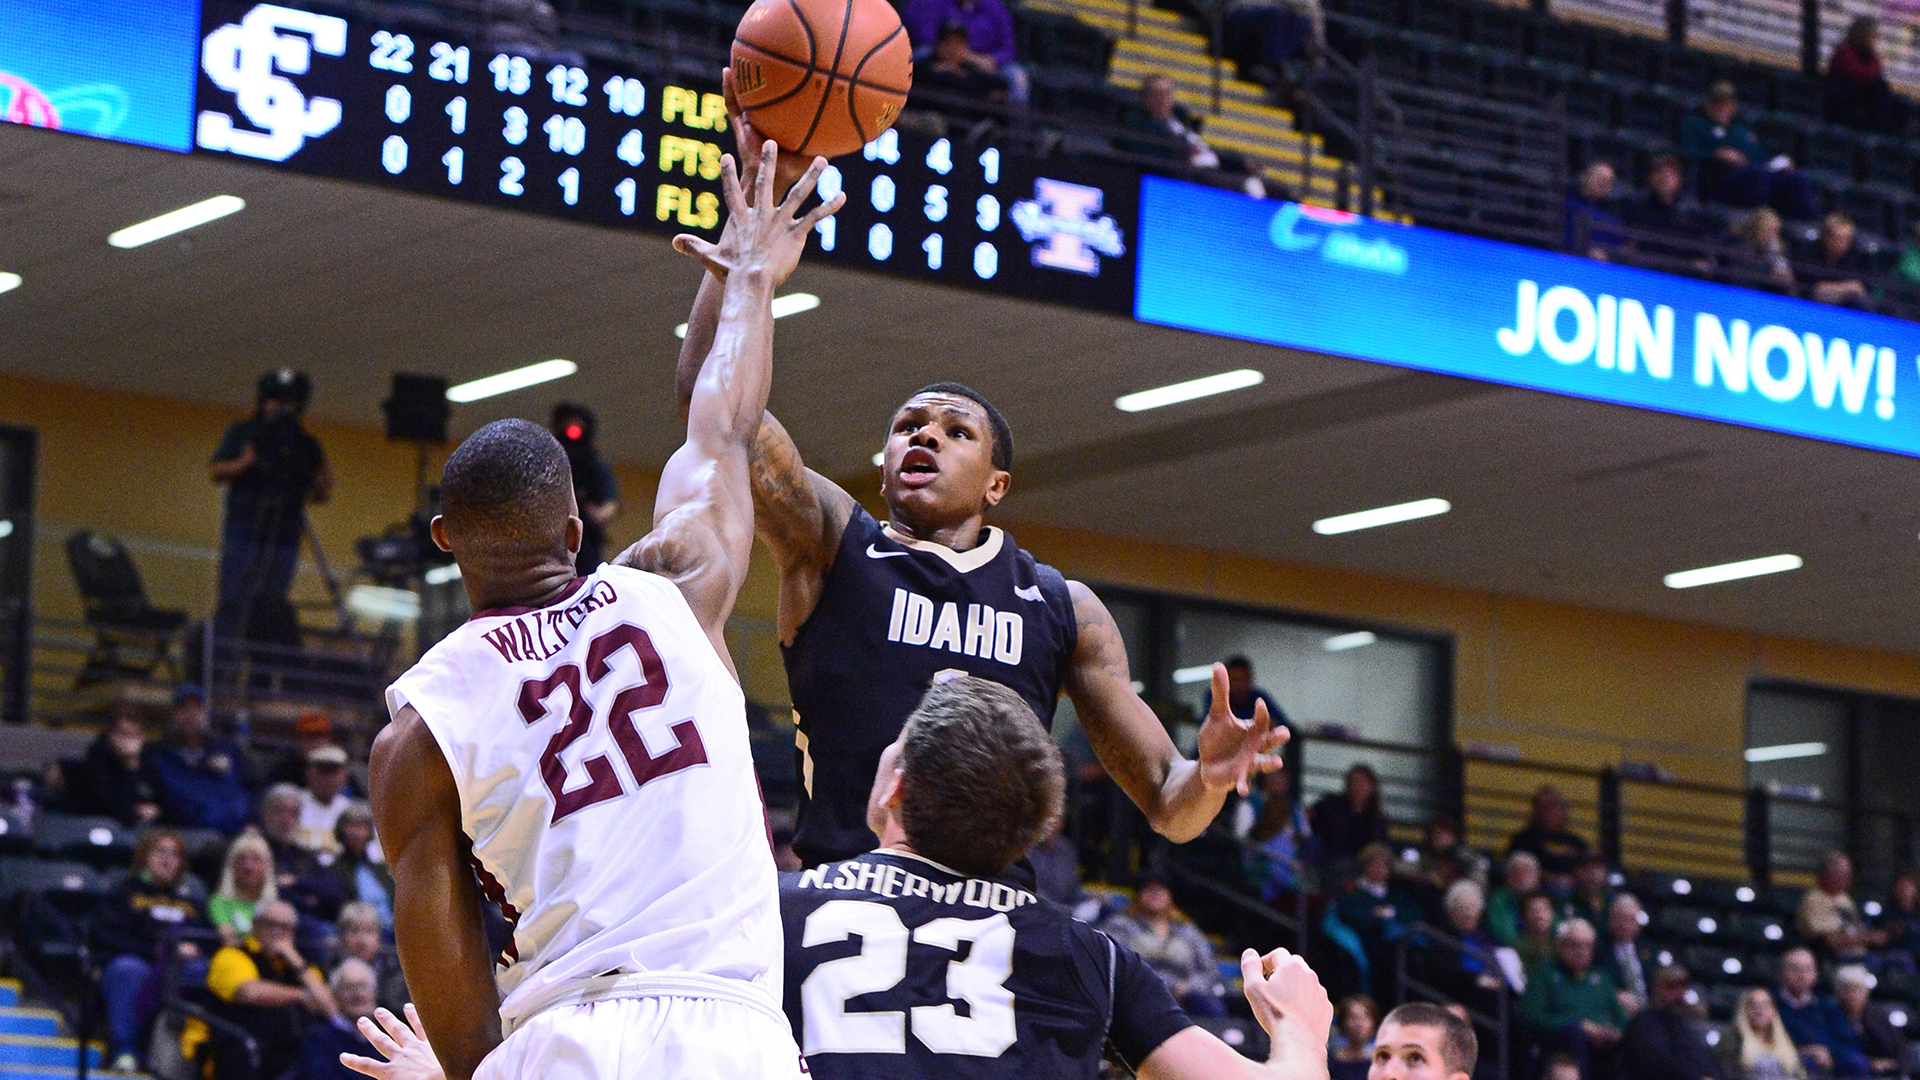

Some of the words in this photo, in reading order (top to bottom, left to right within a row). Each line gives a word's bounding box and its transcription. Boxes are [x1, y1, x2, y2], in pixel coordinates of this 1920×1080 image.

[369, 30, 415, 74] 22
[428, 41, 470, 84] 21
[487, 52, 531, 96] 13
[546, 64, 588, 107] 12
[602, 75, 646, 118] 10
[662, 85, 728, 132] PLR
[925, 138, 953, 175] 4
[978, 147, 1000, 184] 1
[384, 84, 412, 124] 0
[444, 96, 467, 135] 1
[502, 106, 529, 145] 3
[543, 115, 586, 156] 10
[616, 129, 645, 167] 4
[659, 134, 721, 180] PTS
[816, 164, 843, 202] 0
[870, 174, 896, 213] 0
[923, 184, 949, 222] 5
[975, 194, 1001, 232] 9
[381, 135, 409, 175] 0
[441, 146, 464, 185] 1
[498, 156, 525, 196] 2
[557, 167, 580, 206] 1
[614, 177, 637, 216] 1
[656, 184, 719, 230] FLS
[815, 214, 837, 252] 1
[868, 222, 893, 261] 0
[921, 232, 943, 270] 1
[973, 241, 998, 279] 0
[1497, 279, 1675, 379] JOIN
[1693, 312, 1897, 421] NOW!
[887, 587, 1024, 666] IDAHO
[514, 621, 711, 828] 22
[801, 899, 1018, 1059] 23
